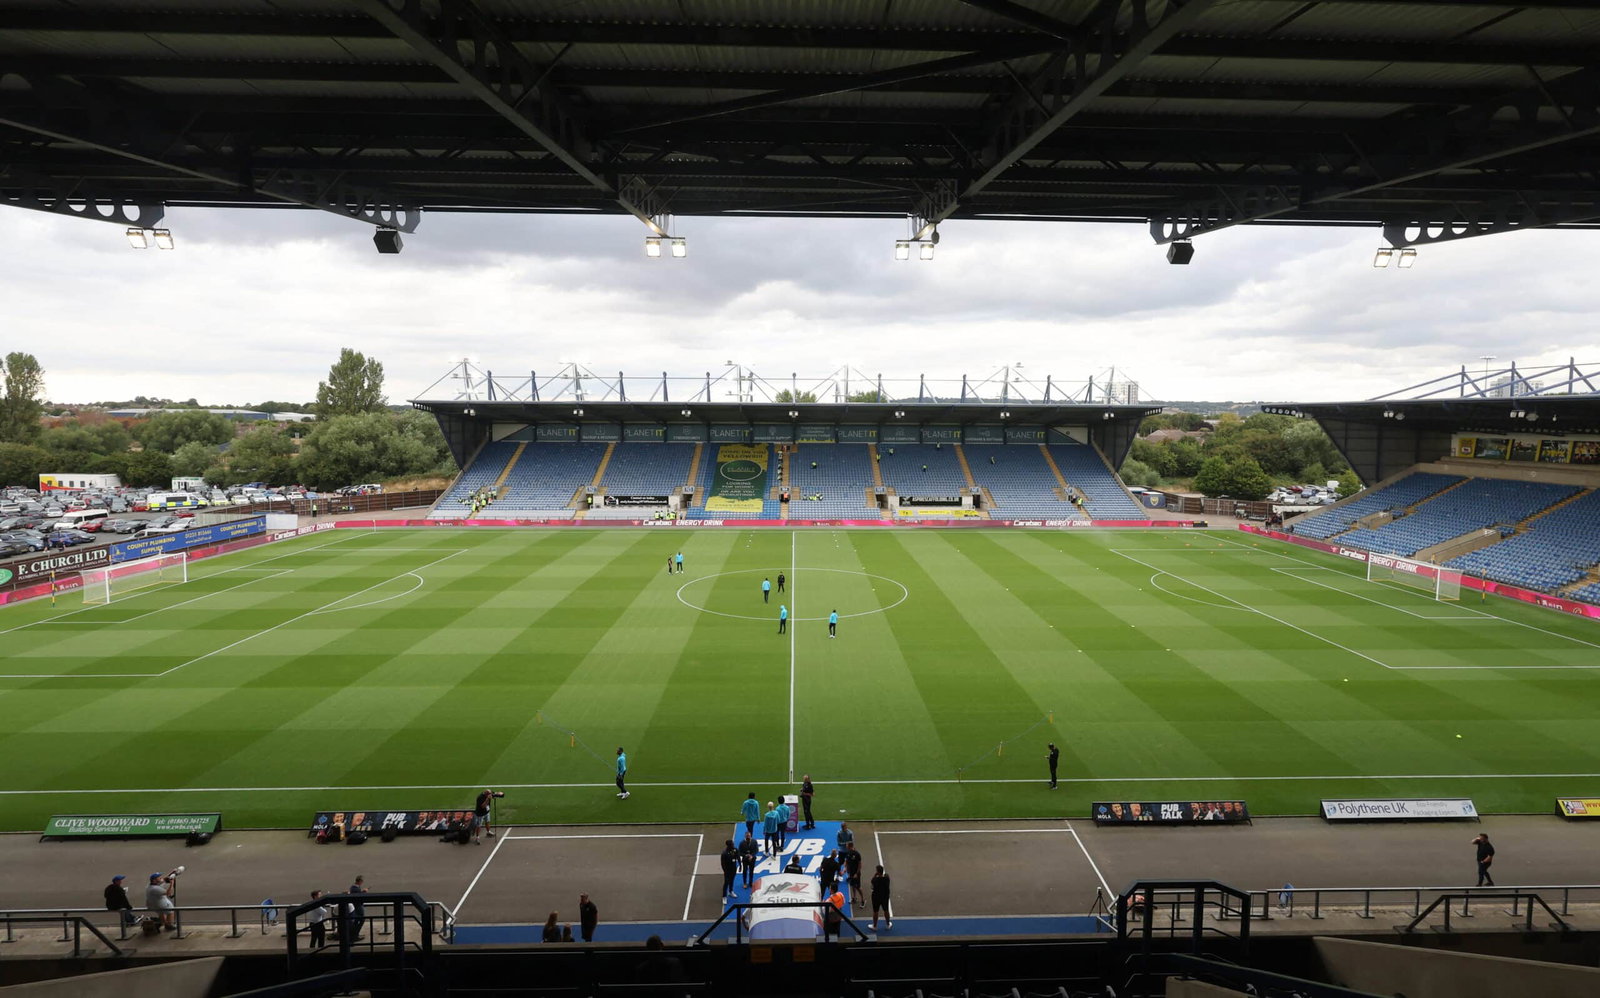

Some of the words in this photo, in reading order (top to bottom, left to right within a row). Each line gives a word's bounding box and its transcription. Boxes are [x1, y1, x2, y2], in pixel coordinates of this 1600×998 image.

[298, 525, 316, 535] ENERGY
[316, 522, 336, 530] DRINK
[127, 541, 148, 550] COUNTY
[149, 536, 176, 546] PLUMBING
[31, 555, 83, 572] CHURCH
[86, 549, 107, 561] LTD
[1369, 554, 1394, 567] ENERGY
[1396, 561, 1418, 573] DRINK
[1161, 804, 1179, 812] PUB
[1338, 803, 1391, 816] Polythene
[1392, 802, 1409, 813] UK
[386, 813, 406, 821] PUB
[1161, 811, 1183, 819] TALK
[55, 819, 85, 828] CLIVE
[87, 818, 150, 827] WOODWARD
